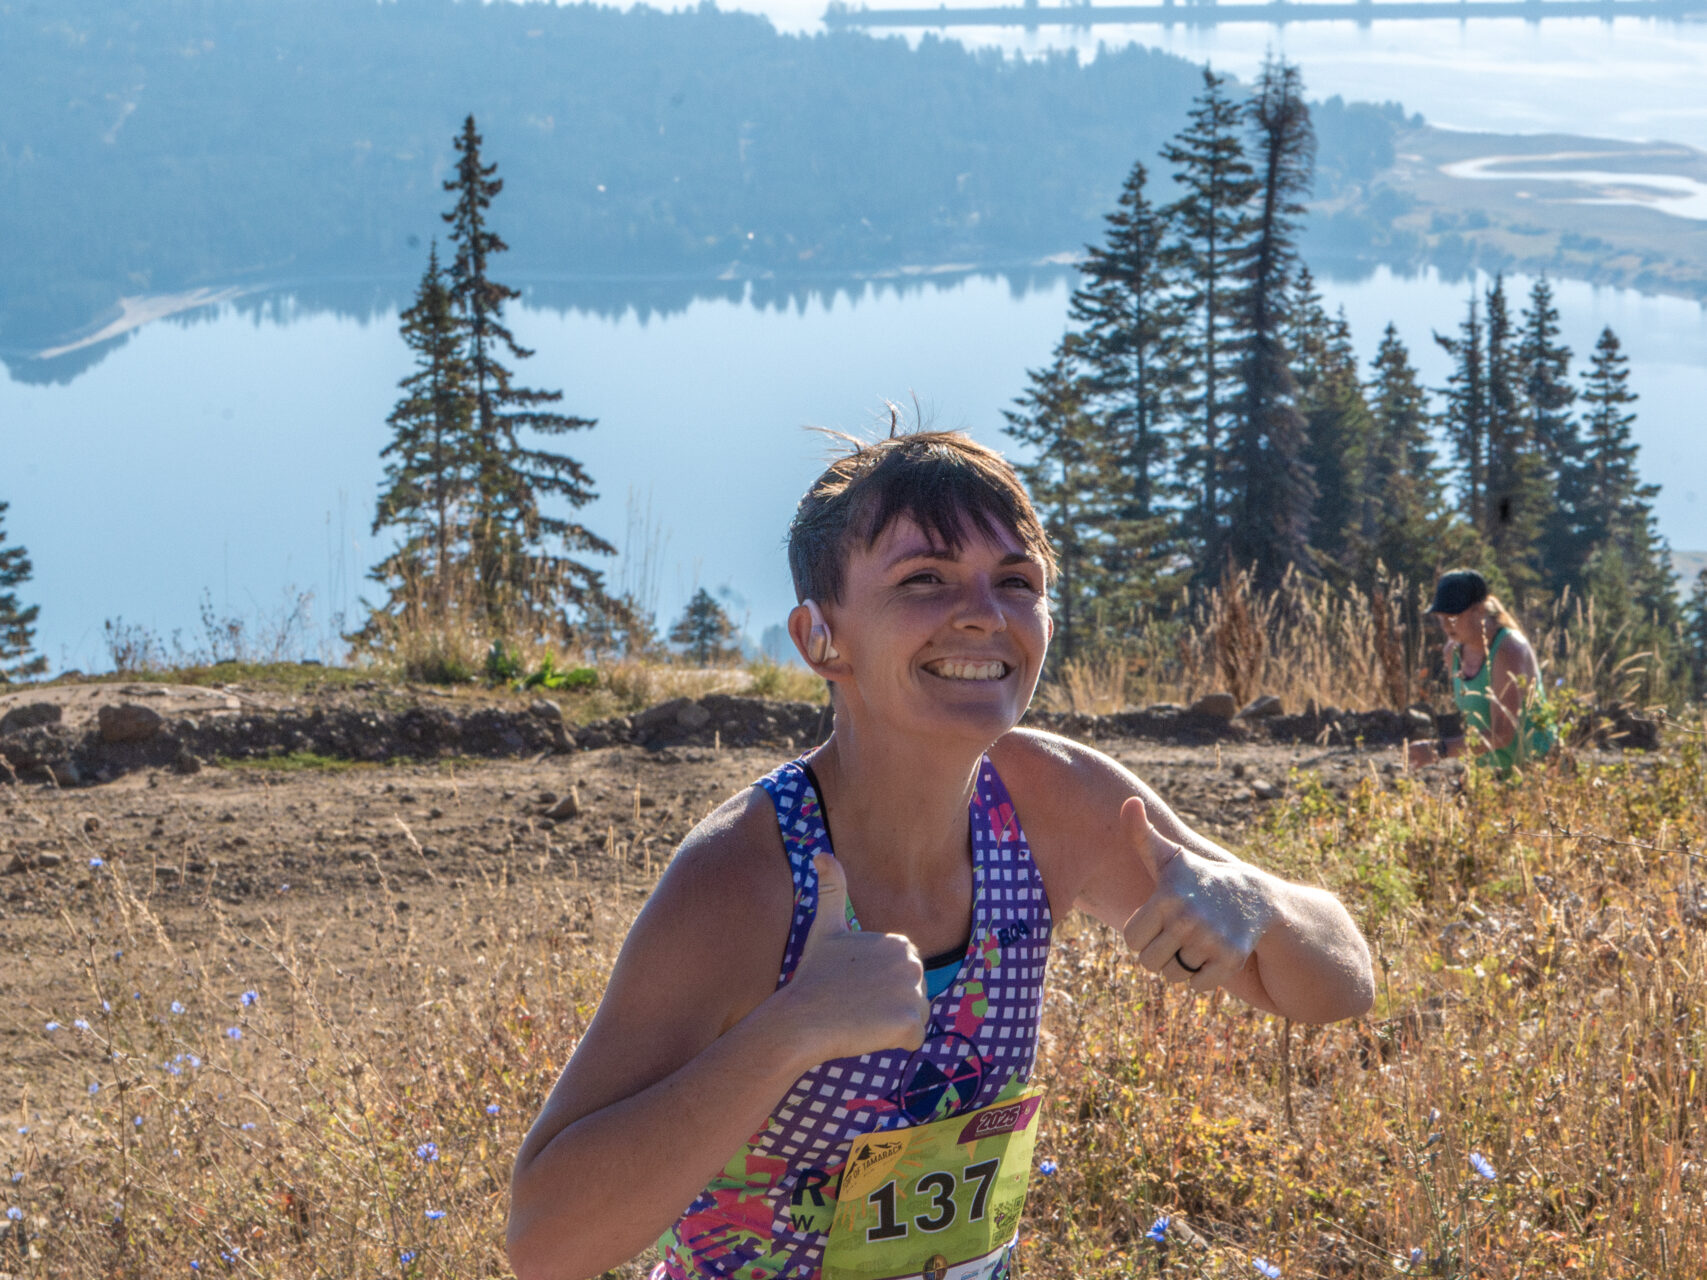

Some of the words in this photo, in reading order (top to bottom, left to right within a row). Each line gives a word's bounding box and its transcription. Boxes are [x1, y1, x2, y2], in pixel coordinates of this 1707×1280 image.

[976, 1105, 1021, 1132] 2025
[863, 1143, 903, 1170] TAMARACK
[866, 1158, 1000, 1243] 137
